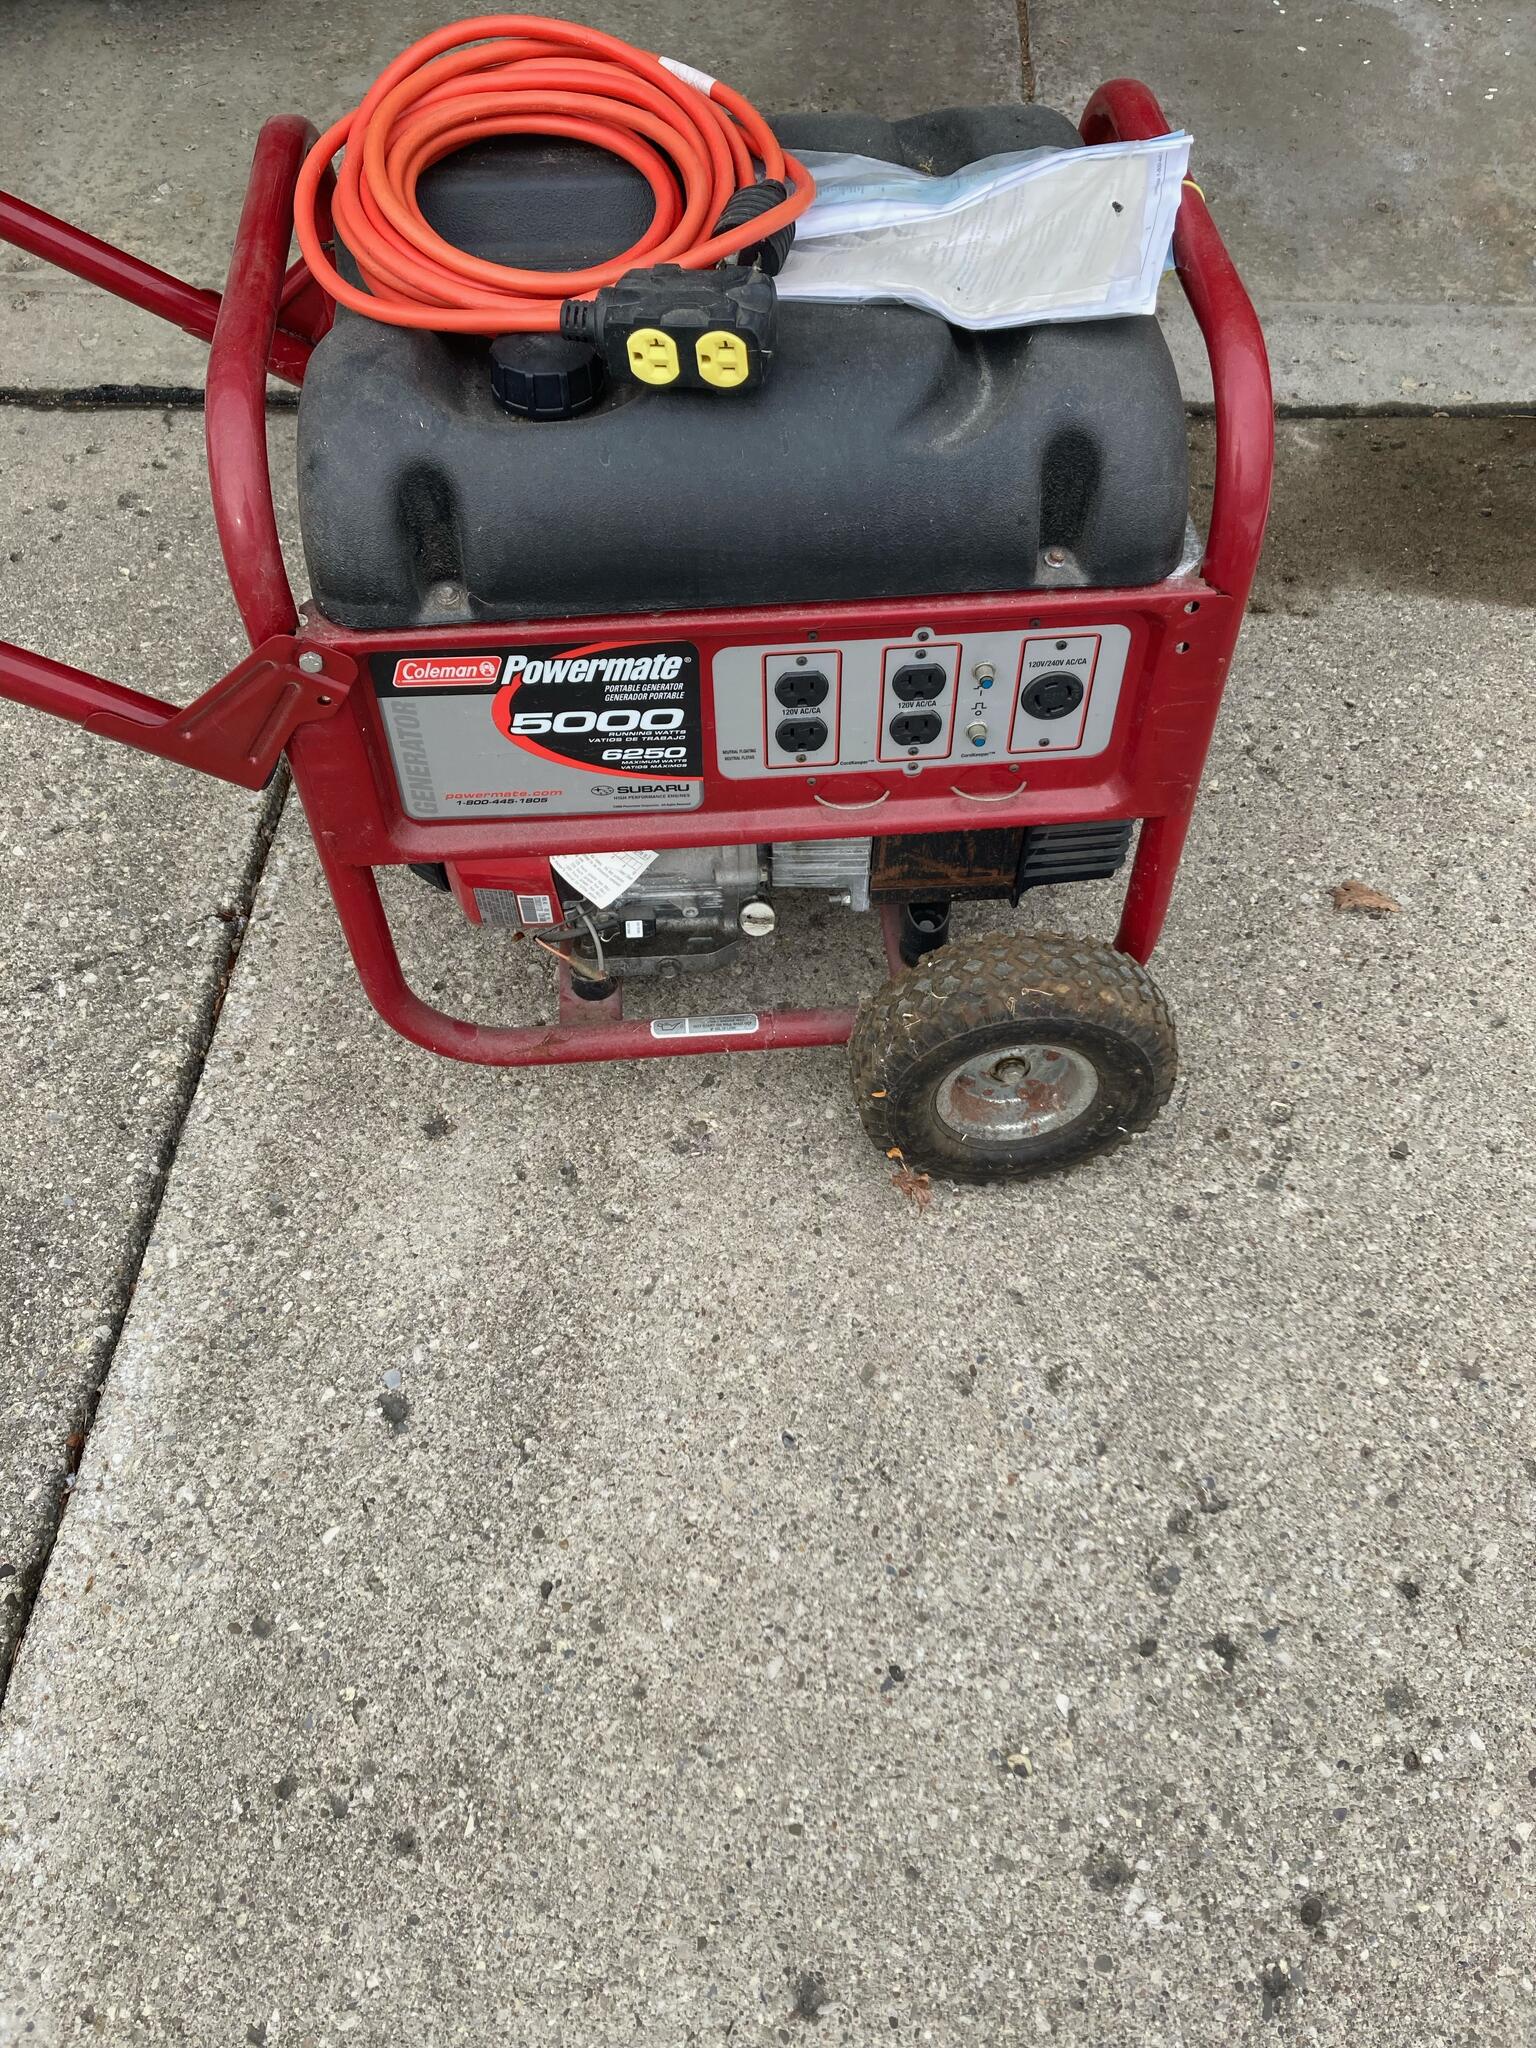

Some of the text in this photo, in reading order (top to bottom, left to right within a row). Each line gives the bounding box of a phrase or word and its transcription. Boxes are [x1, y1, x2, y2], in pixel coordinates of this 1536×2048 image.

[1029, 658, 1087, 668] 120V/240V AC/CA
[402, 662, 478, 680] Coleman
[604, 682, 684, 693] PORTABLE GENERATOR
[604, 691, 685, 702] GENERADOR PORTABLE
[915, 700, 937, 708] AC/CA
[782, 707, 821, 716] 120V AC/CA
[510, 708, 685, 734] 5000
[391, 700, 438, 814] GENERATOR
[601, 747, 687, 760] 6250
[617, 783, 690, 794] SUBARU
[445, 789, 563, 800] powermate.com
[456, 797, 548, 806] 1-800-445-1805
